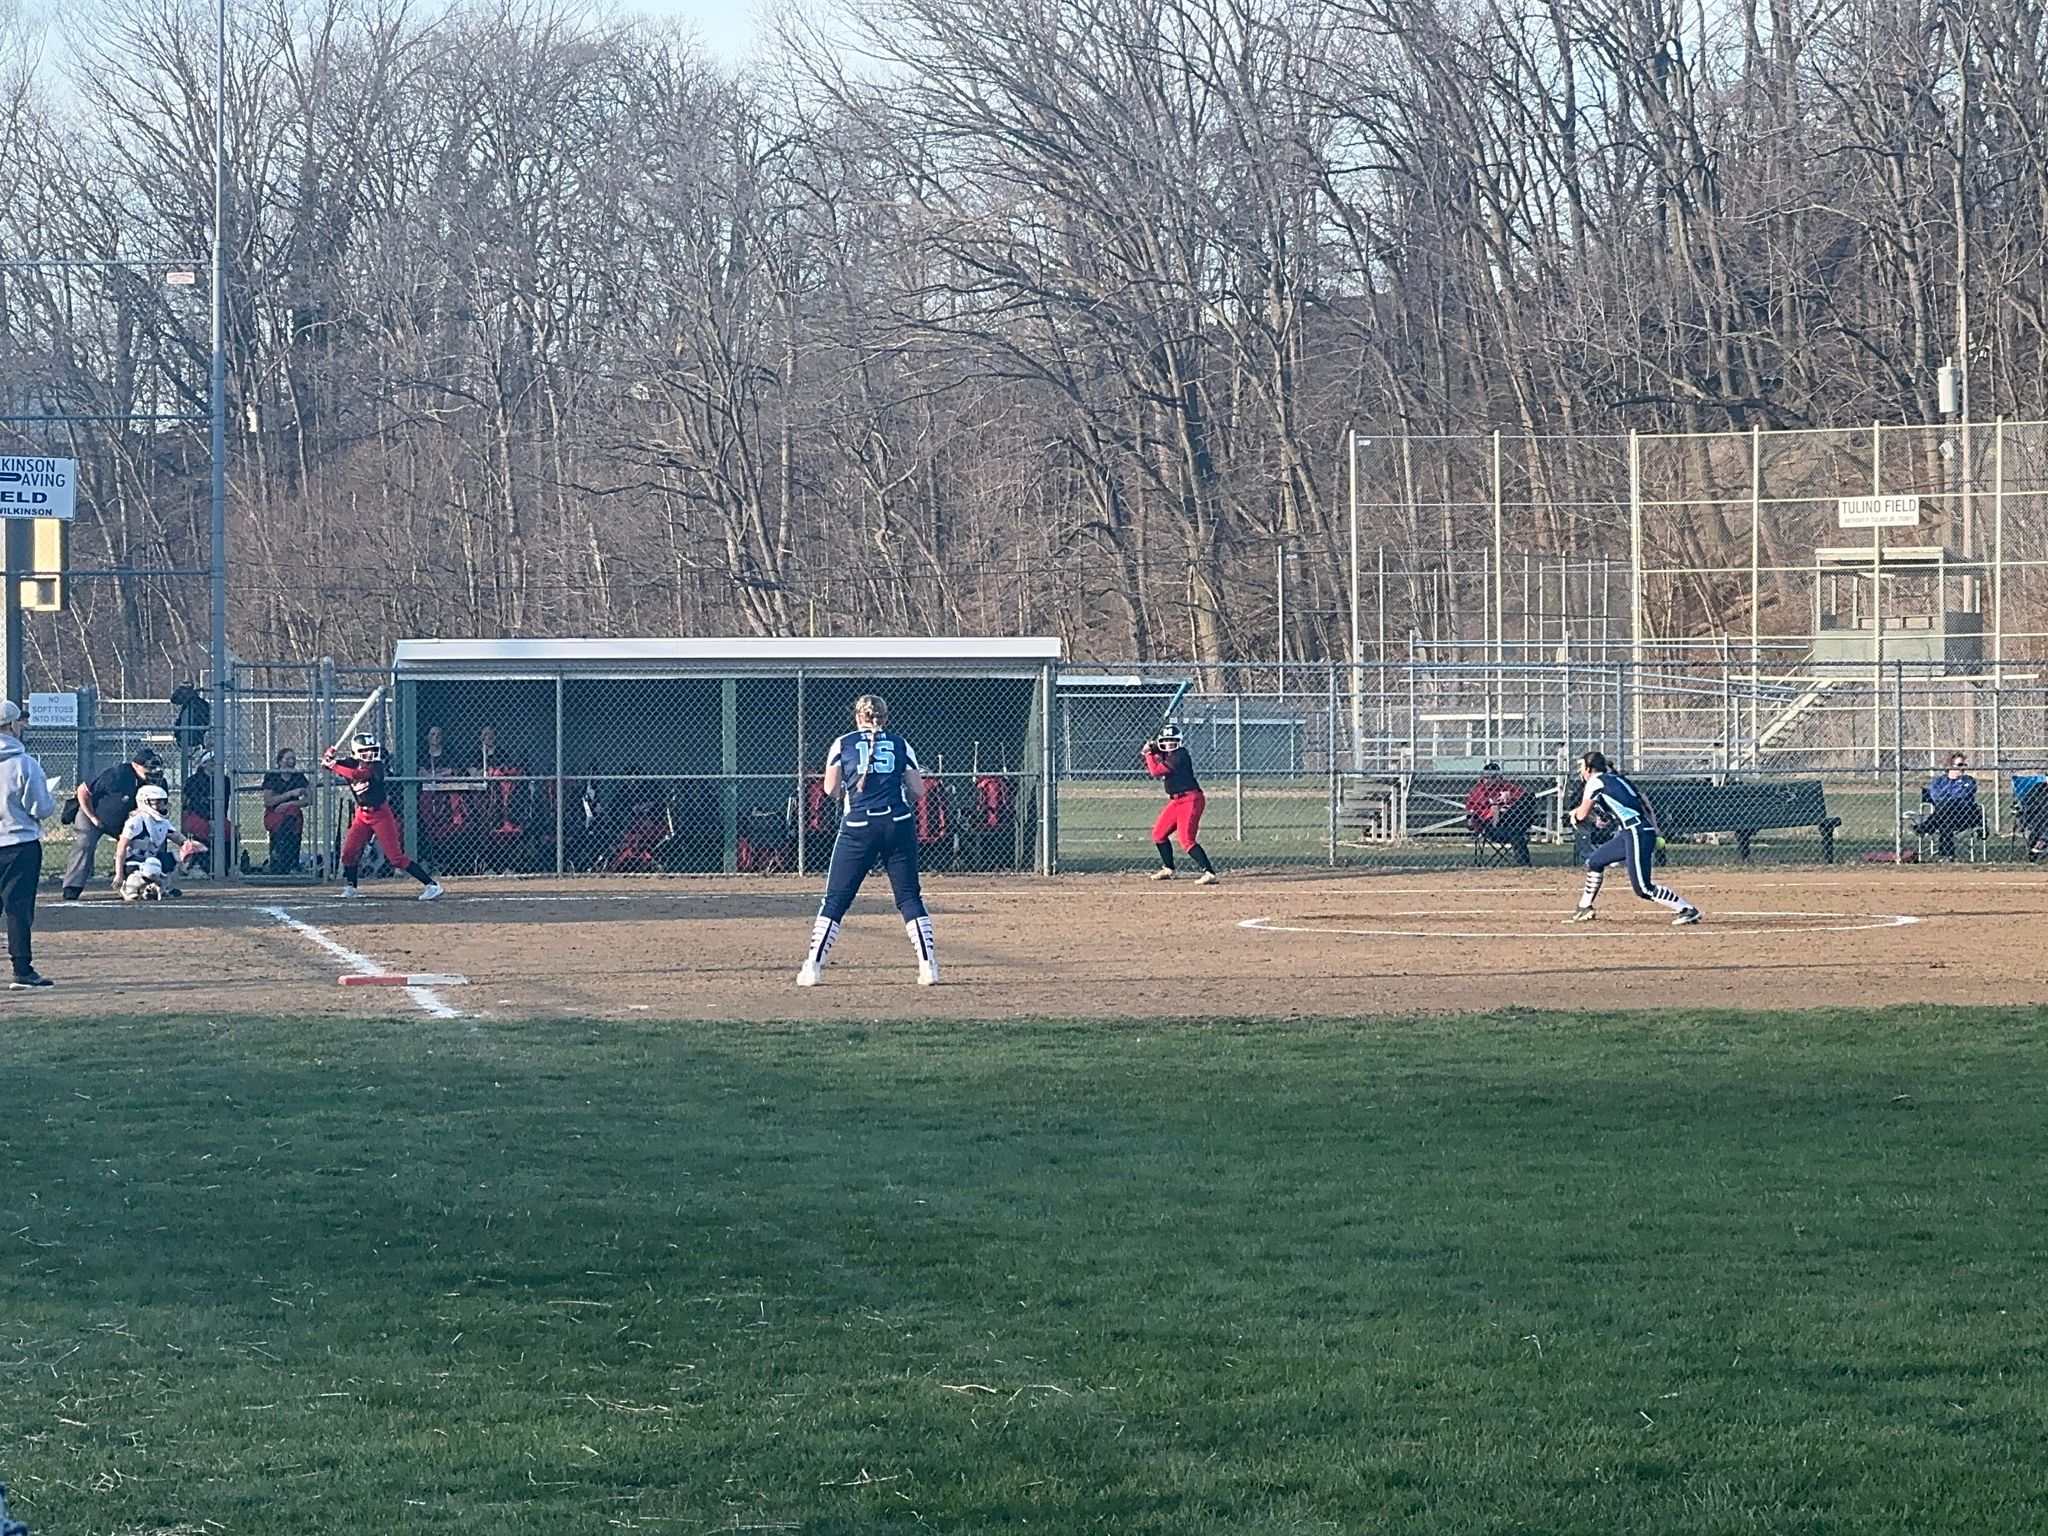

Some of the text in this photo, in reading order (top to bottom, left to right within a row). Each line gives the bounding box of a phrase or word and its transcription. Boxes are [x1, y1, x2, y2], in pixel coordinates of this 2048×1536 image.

[0, 458, 55, 472] KINSON
[0, 491, 47, 503] ELD
[1842, 499, 1916, 513] TULINO FIELD
[32, 705, 74, 713] SOFT TOSS
[855, 740, 896, 774] 15
